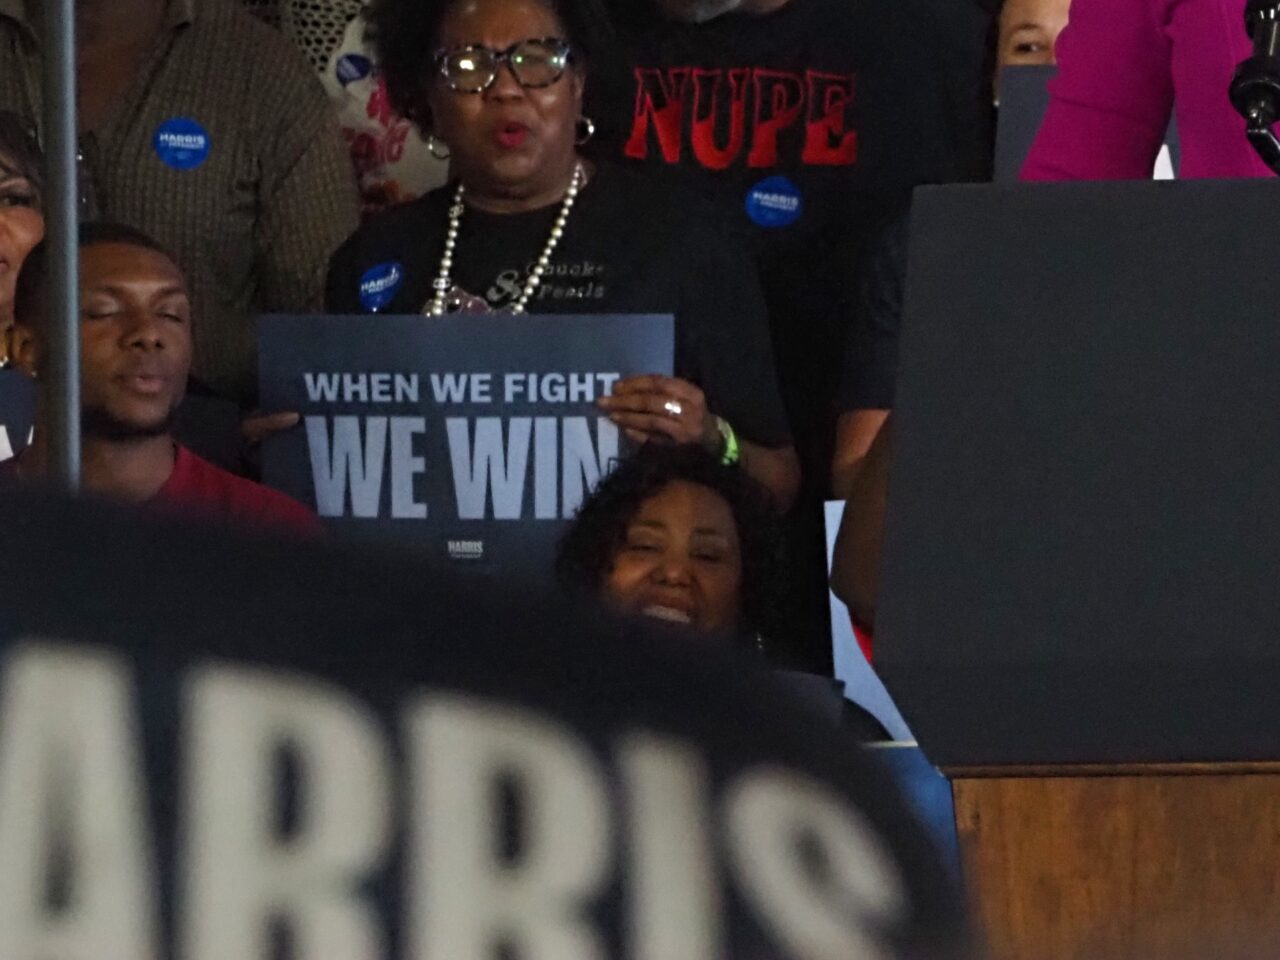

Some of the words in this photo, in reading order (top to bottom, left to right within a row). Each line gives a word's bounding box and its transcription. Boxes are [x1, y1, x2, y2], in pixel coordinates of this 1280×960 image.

[624, 66, 857, 170] NUPE
[305, 372, 419, 402] WHEN
[430, 373, 492, 403] WE
[504, 372, 620, 403] FIGHT
[304, 415, 427, 519] WE
[445, 416, 619, 520] WIN
